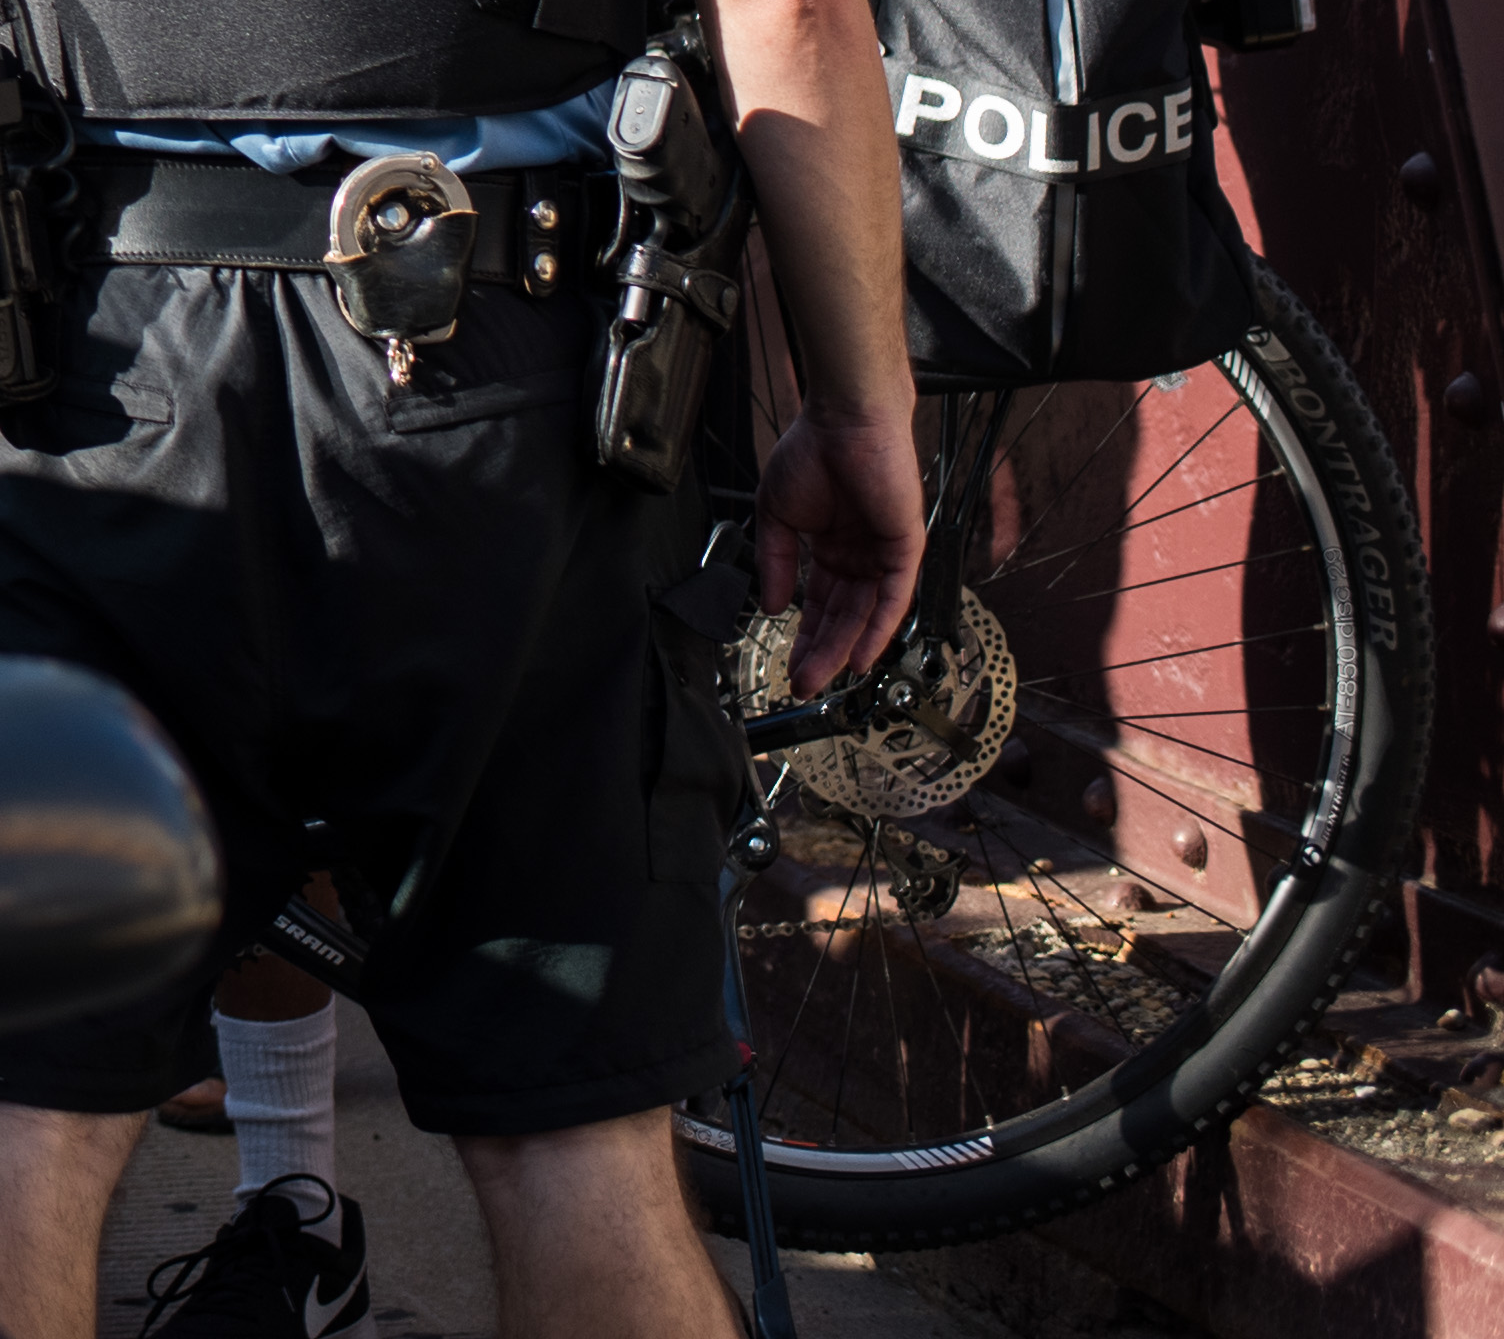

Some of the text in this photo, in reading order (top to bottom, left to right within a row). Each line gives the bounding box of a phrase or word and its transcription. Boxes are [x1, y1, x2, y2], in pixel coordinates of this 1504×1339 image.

[894, 73, 1195, 174] POLICE
[1274, 359, 1397, 651] BONTRAGER
[1321, 546, 1358, 844] BONTRAGER AT-850 disc 29
[272, 914, 346, 967] SRAM
